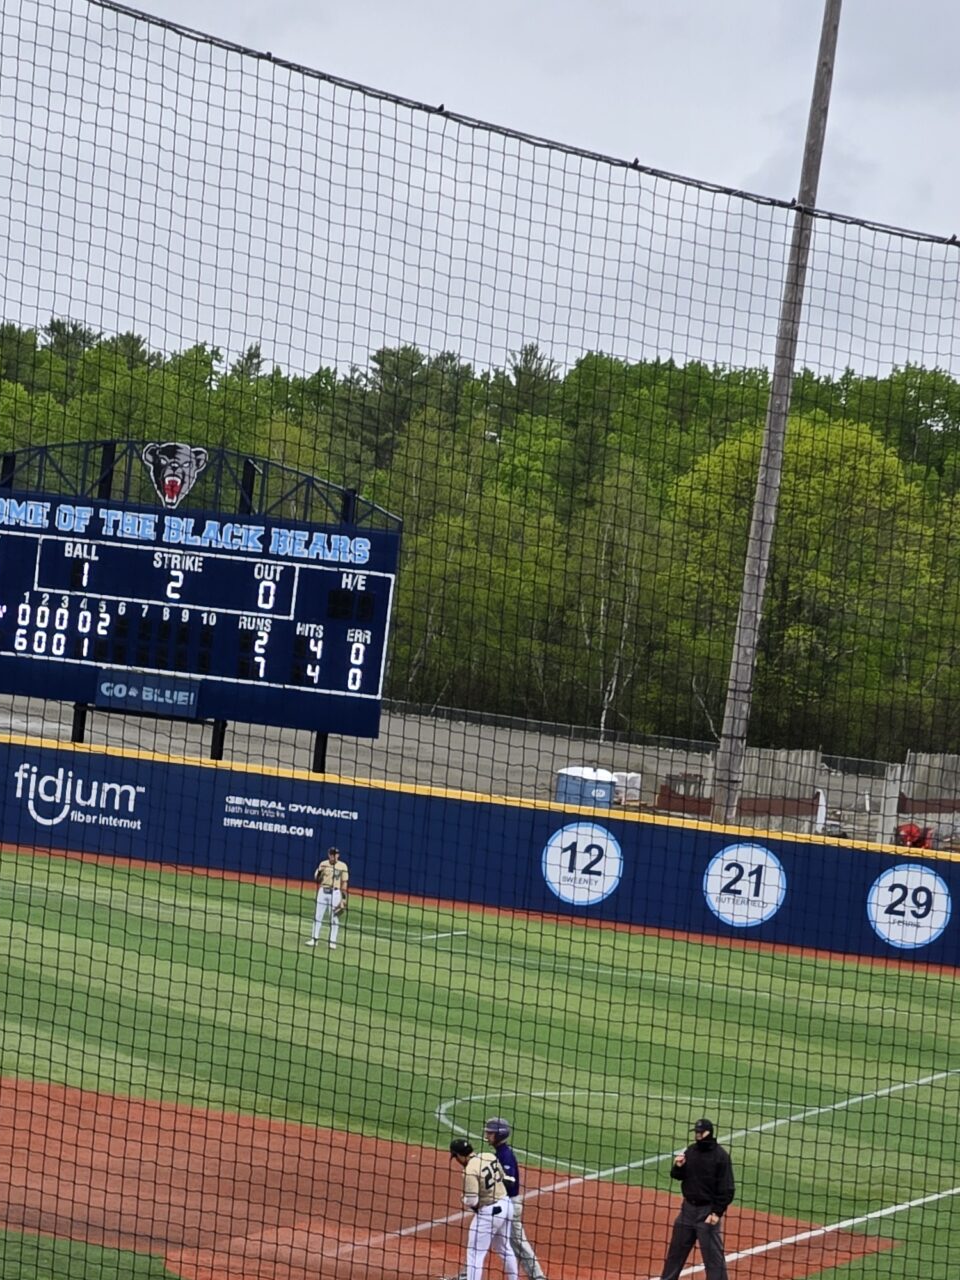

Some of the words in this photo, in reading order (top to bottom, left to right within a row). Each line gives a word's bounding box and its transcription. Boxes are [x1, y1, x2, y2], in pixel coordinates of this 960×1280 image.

[55, 504, 93, 533] OF
[99, 508, 158, 541] THE
[162, 516, 265, 552] BLACK
[269, 528, 371, 564] BEARS
[64, 542, 99, 561] BALL
[153, 552, 203, 572] STRIKE
[82, 562, 90, 587] 1
[166, 570, 184, 599] 2
[254, 563, 284, 581] OUT
[341, 573, 367, 591] H/E
[23, 591, 30, 604] 1
[41, 593, 50, 606] 2
[61, 595, 69, 608] 3
[80, 598, 88, 610] 4
[99, 600, 106, 612] 5
[118, 602, 126, 615] 6
[141, 605, 148, 617] 7
[162, 607, 170, 621] 8
[182, 609, 189, 622] 9
[201, 612, 217, 626] 10
[257, 580, 276, 609] 0
[18, 603, 30, 626] 0
[36, 606, 49, 628] 0
[55, 608, 68, 630] 0
[78, 611, 91, 633] 0
[97, 613, 110, 635] 2
[254, 631, 269, 654] 2
[309, 638, 323, 659] 4
[350, 643, 365, 665] 0
[238, 616, 272, 632] RUNS
[296, 622, 324, 638] HITS
[347, 629, 371, 644] ERR
[14, 629, 27, 650] 6
[33, 631, 46, 653] 0
[52, 633, 65, 655] 0
[82, 638, 89, 657] 1
[254, 656, 266, 678] 7
[306, 664, 320, 684] 4
[347, 668, 362, 691] 0
[100, 682, 127, 698] GO
[142, 686, 195, 705] BLUE!
[14, 763, 137, 812] fidium
[70, 810, 97, 824] fiber
[99, 814, 141, 830] internet
[225, 795, 286, 811] GENERAL
[289, 803, 359, 820] DYNAMICS
[561, 841, 605, 877] 12
[721, 862, 763, 897] 21
[884, 883, 933, 919] 29
